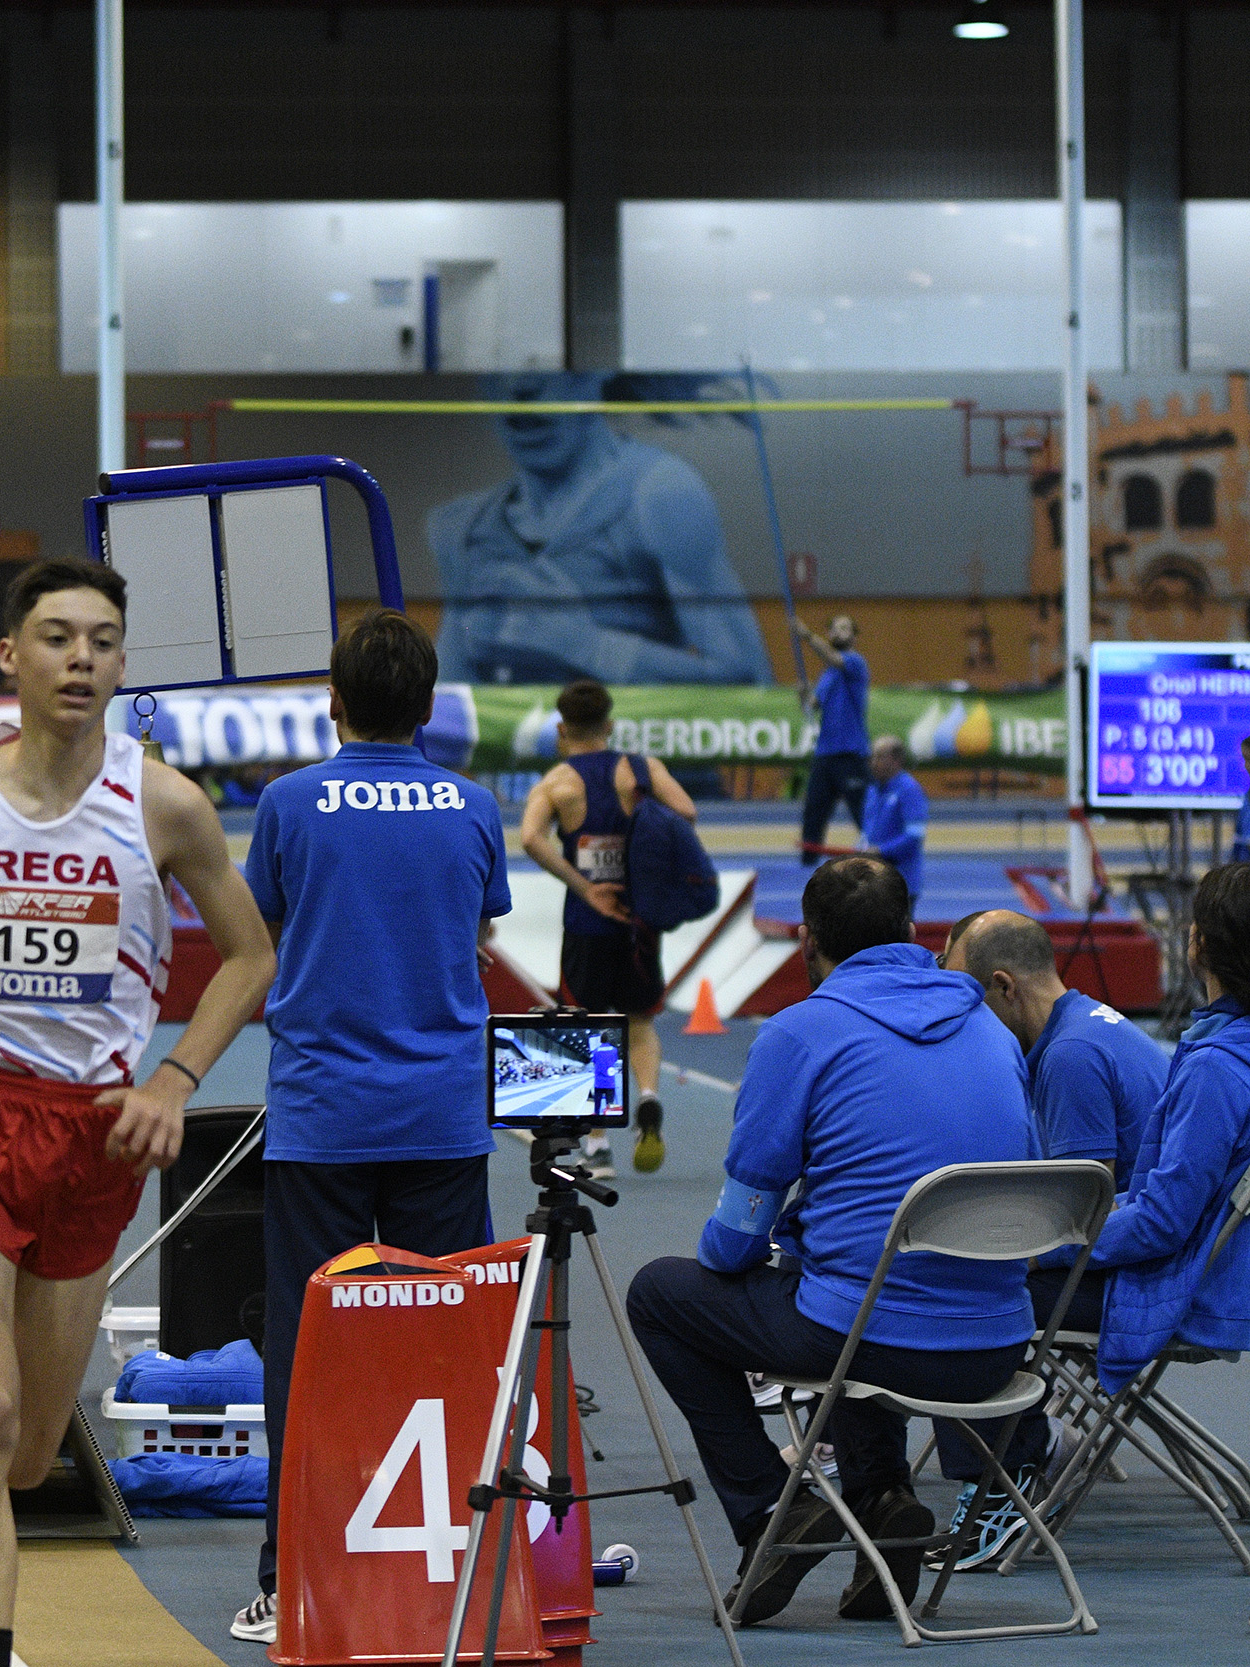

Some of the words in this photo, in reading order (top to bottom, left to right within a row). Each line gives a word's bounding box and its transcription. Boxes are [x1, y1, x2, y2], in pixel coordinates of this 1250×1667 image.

[162, 698, 341, 768] Jom
[1000, 718, 1068, 757] IBE
[316, 779, 466, 814] Joma
[331, 1283, 466, 1309] MONDO
[344, 1398, 471, 1583] 4
